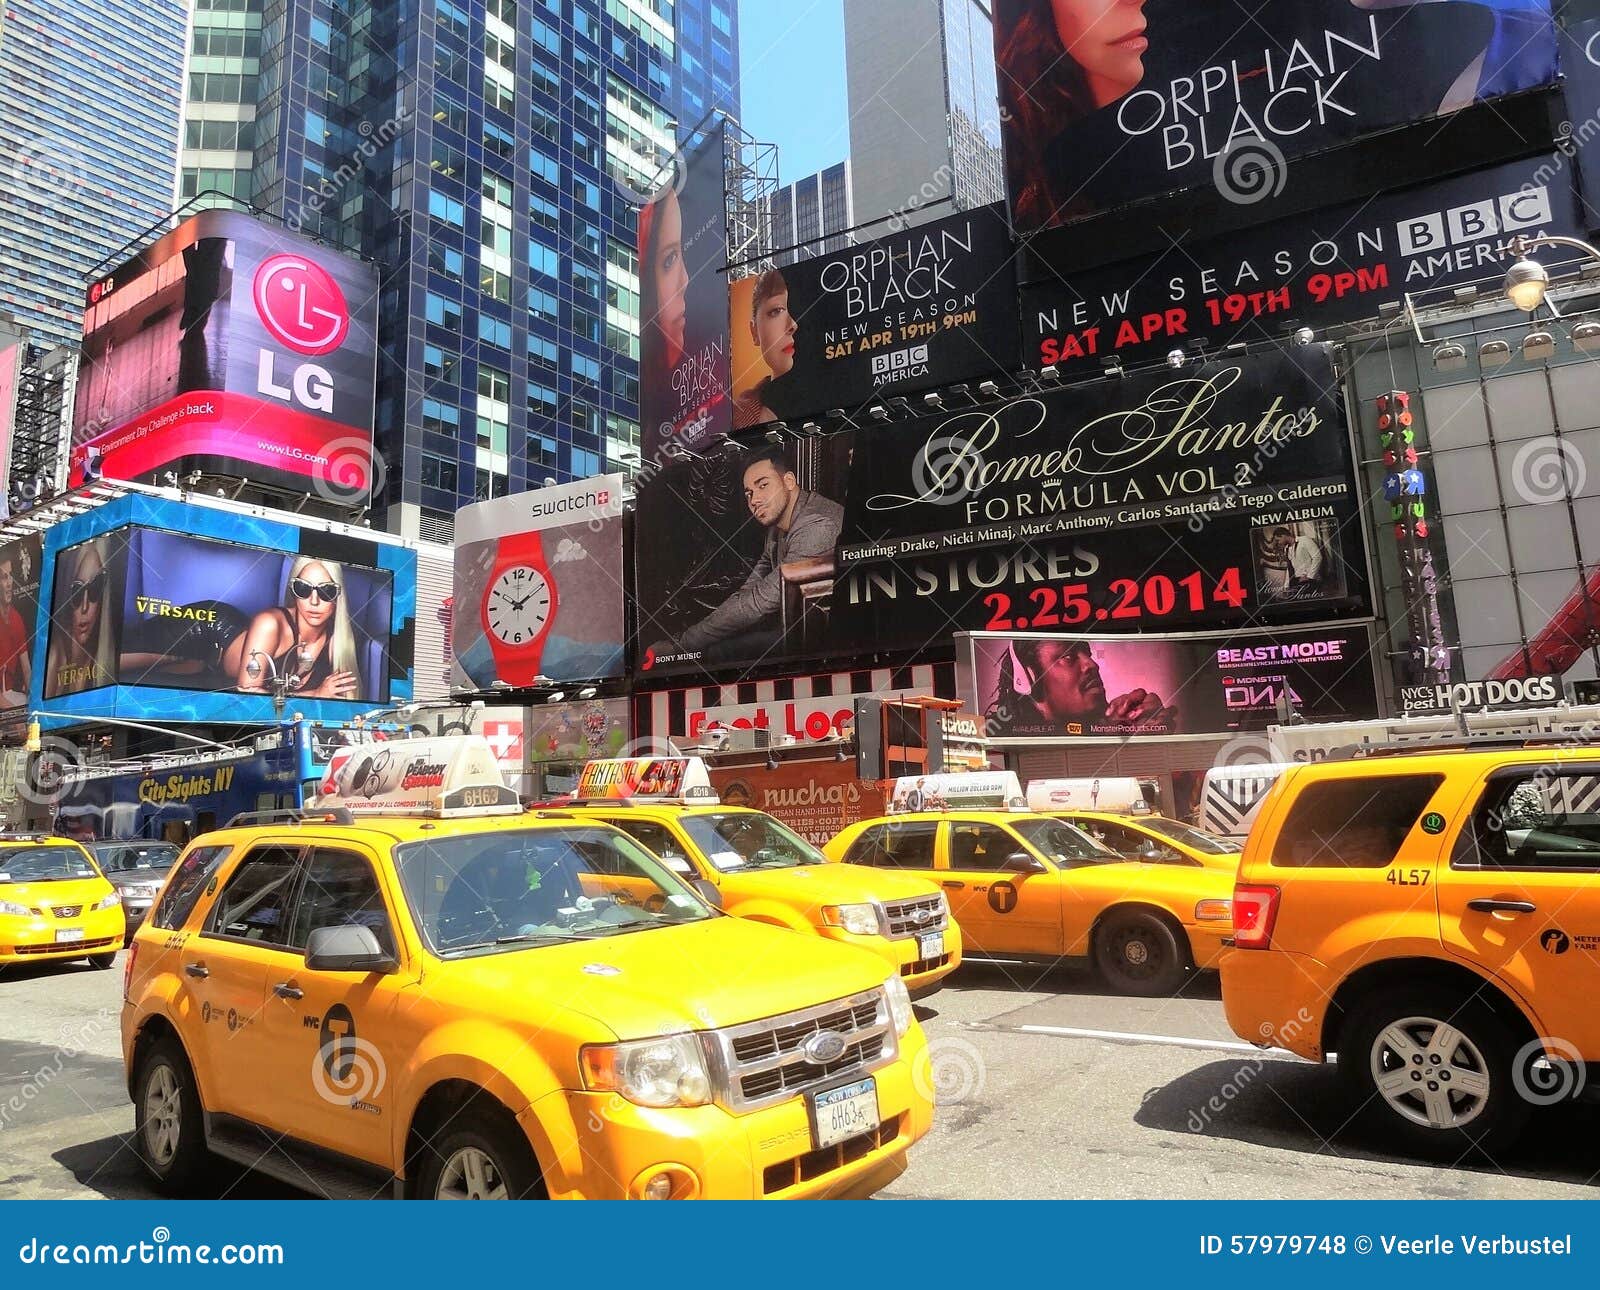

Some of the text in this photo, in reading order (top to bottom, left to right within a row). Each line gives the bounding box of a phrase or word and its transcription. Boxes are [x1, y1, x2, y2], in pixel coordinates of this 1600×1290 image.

[1116, 14, 1382, 137] ORPHAN
[1161, 70, 1358, 171] BLACK
[1396, 185, 1553, 257] BBC
[819, 221, 973, 294] ORPHAN
[1037, 227, 1384, 334] NEW SEASON
[846, 256, 957, 319] BLACK
[1040, 261, 1390, 366] SAT APR 19TH 9PM
[824, 293, 977, 345] NEW SEASON
[824, 309, 978, 361] SAT APR 19TH 9PM
[257, 348, 334, 414] LG
[671, 333, 723, 391] ORPHAN
[680, 359, 717, 407] BLACK
[871, 344, 929, 375] BBC
[873, 364, 929, 387] AMERICA
[101, 429, 136, 455] Environment
[136, 424, 149, 438] Day
[148, 411, 179, 432] Challenge
[186, 402, 214, 415] back
[257, 439, 329, 466] www.LG.com
[865, 398, 1083, 512] Romeo
[1068, 366, 1324, 475] Santos
[531, 492, 597, 518] swatch
[966, 461, 1253, 524] FORMULA VOL 2
[1251, 505, 1335, 527] NEW ALBUM
[841, 481, 1349, 562] Featuring: Drake, Nicki Minaj, Marc Anthony, Carlos Santana & Tego Calderon
[512, 569, 525, 580] 12
[848, 545, 1100, 605] IN STORES
[982, 566, 1248, 632] 2.25.2014
[136, 600, 217, 622] VERSACE
[655, 652, 702, 664] SONY MUSIC
[1217, 645, 1279, 663] BEAST
[1401, 676, 1557, 708] NYC's HOT DOGS
[1403, 698, 1435, 711] best
[1090, 724, 1168, 733] MonsterProducts.com
[138, 775, 212, 805] CitySights
[213, 766, 235, 792] NY
[1386, 869, 1431, 886] 4L57
[303, 1015, 319, 1029] NYC
